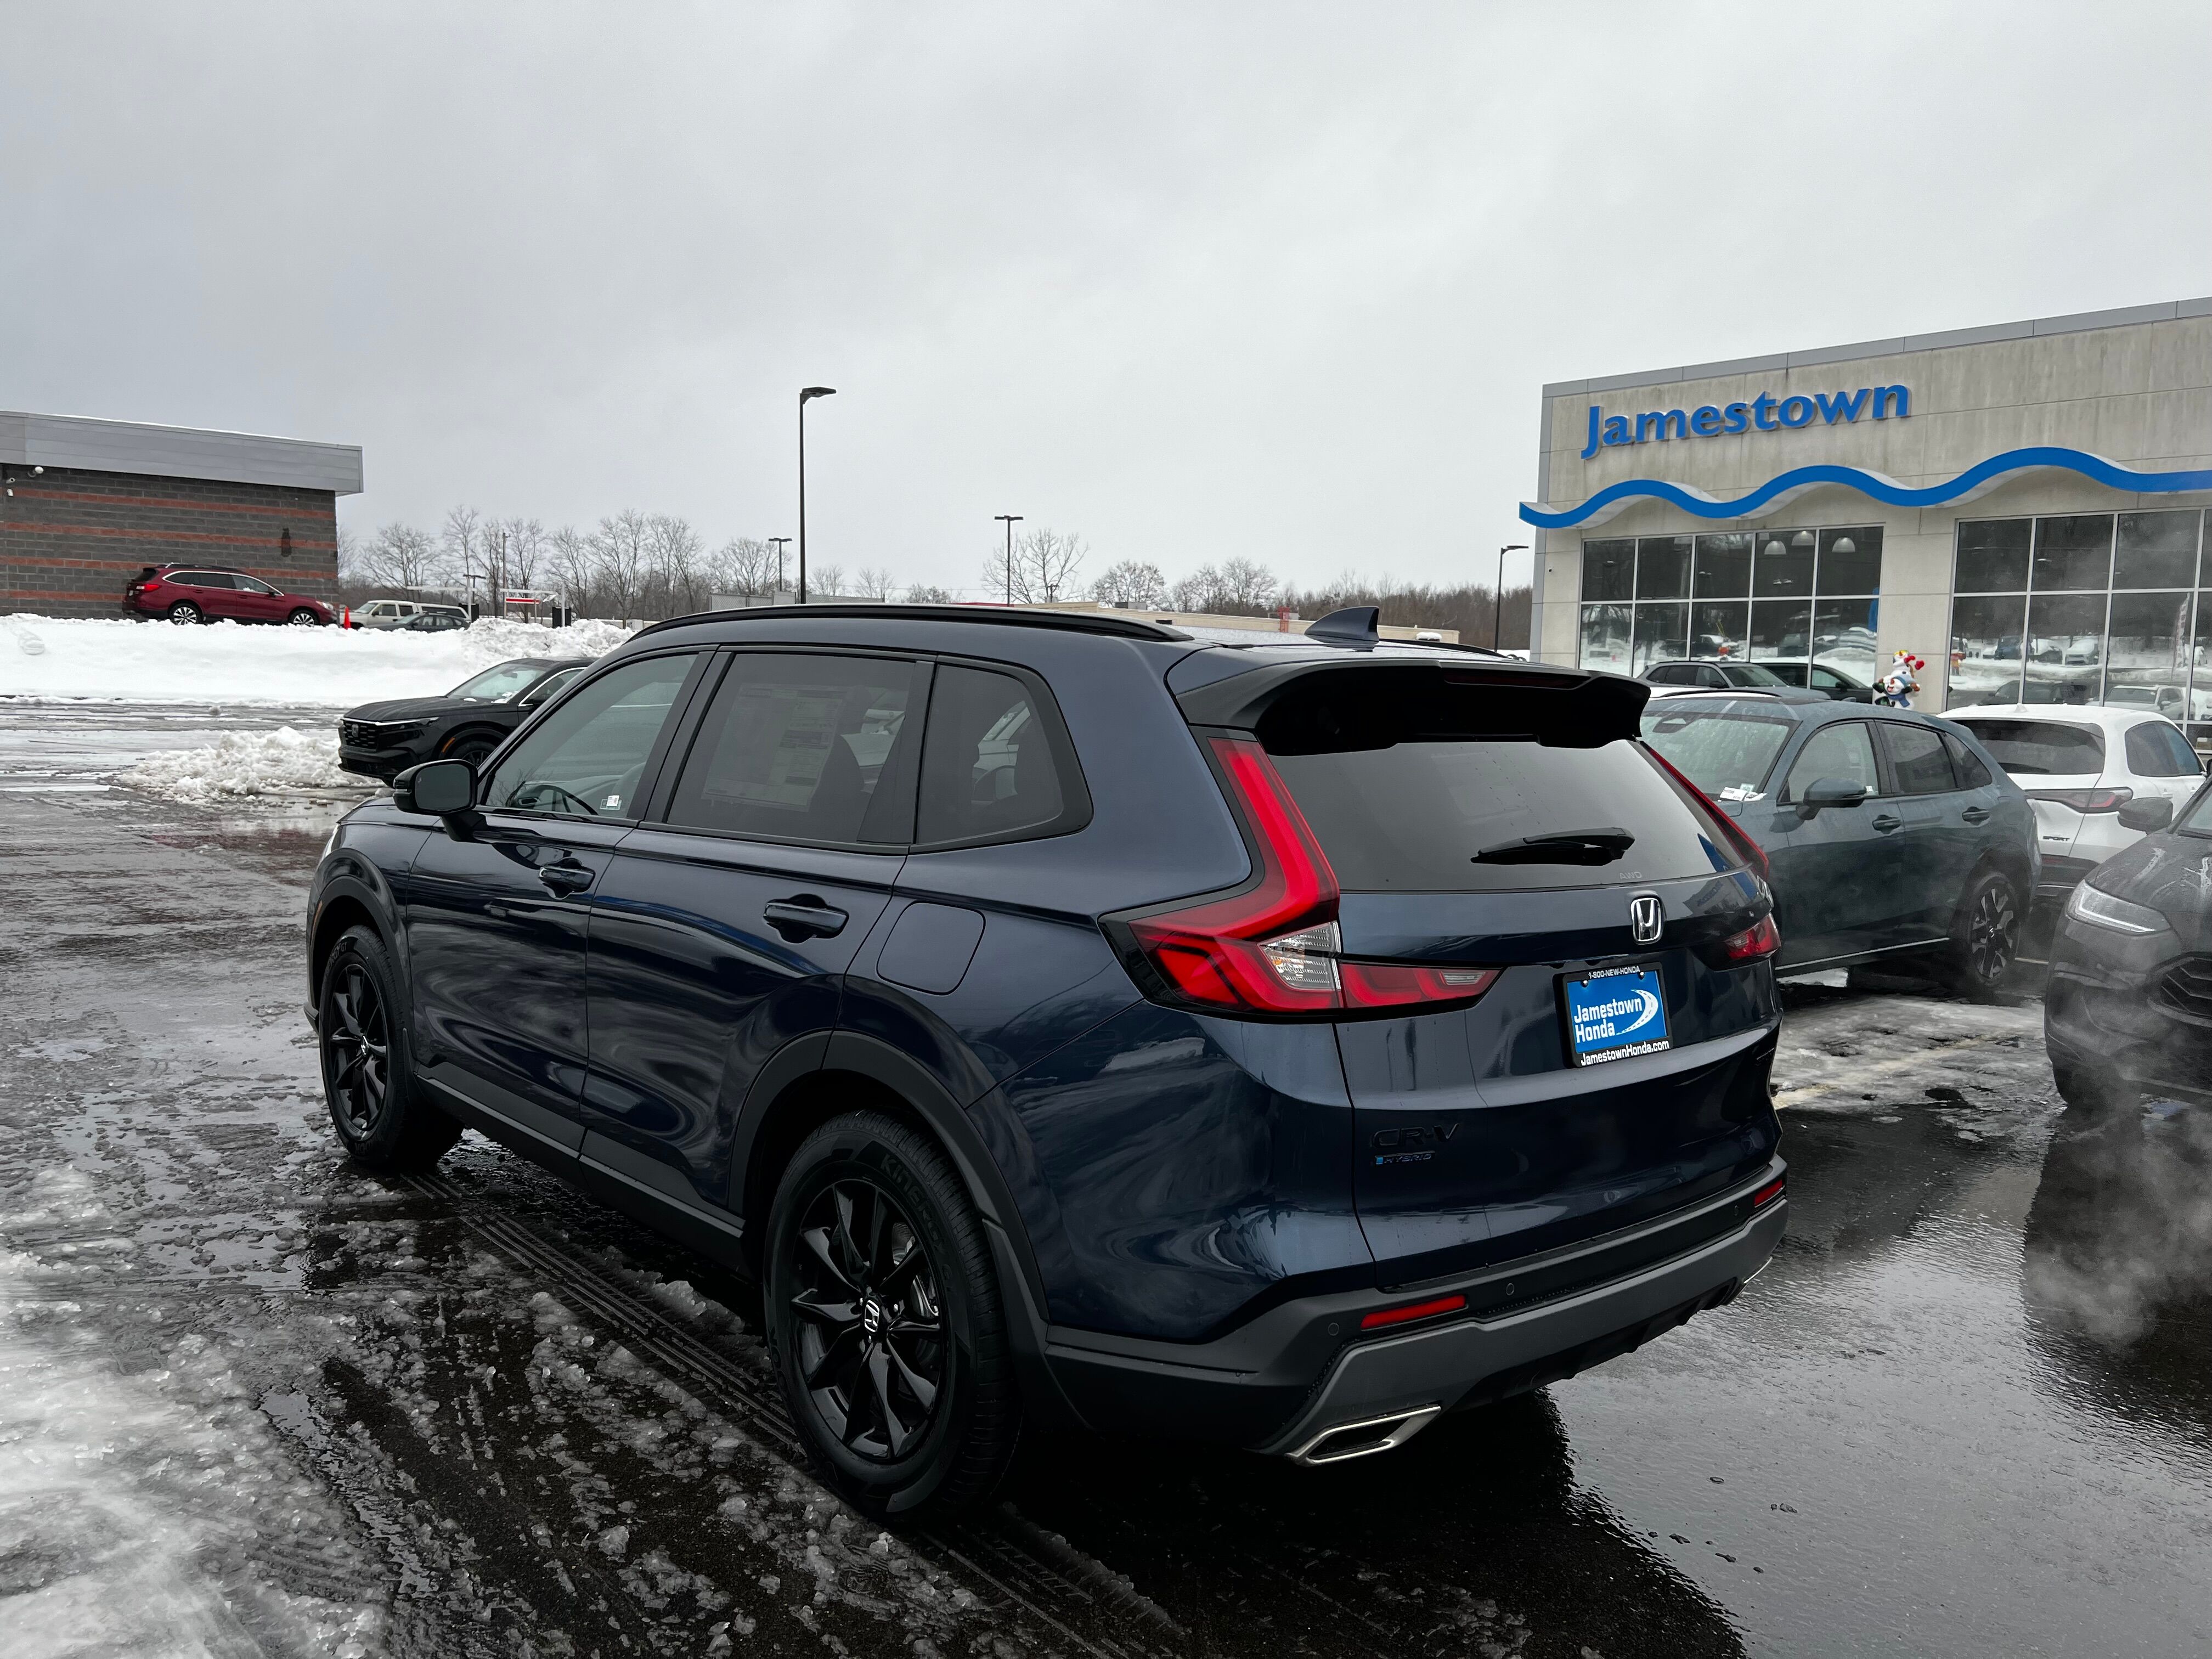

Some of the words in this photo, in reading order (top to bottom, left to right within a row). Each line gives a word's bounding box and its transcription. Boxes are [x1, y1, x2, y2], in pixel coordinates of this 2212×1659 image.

[1581, 383, 1910, 459] Jamestown
[1619, 871, 1642, 880] AWD
[1588, 966, 1640, 979] 1-800-NEW-HONDA
[1574, 997, 1643, 1024] Jamestown
[1576, 1019, 1616, 1043] Honda
[1581, 1039, 1670, 1066] JamestownHonda.com
[1371, 1123, 1460, 1148] CR-V
[1384, 1153, 1432, 1164] HYBRID
